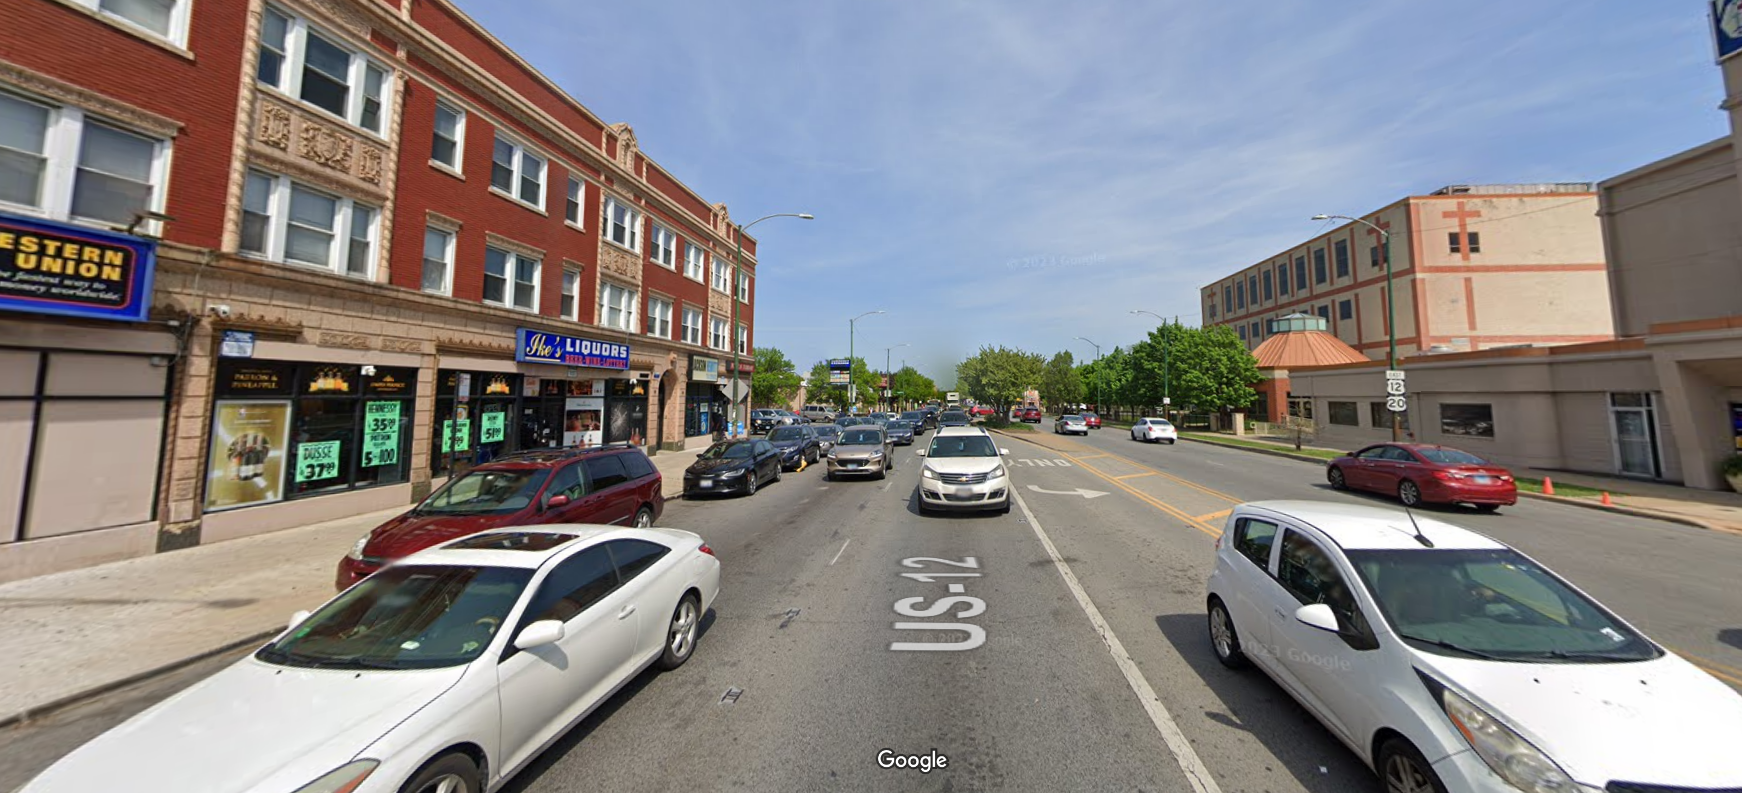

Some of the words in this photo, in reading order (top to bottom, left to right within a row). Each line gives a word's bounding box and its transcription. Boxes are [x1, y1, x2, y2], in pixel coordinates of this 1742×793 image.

[16, 253, 121, 281] UNION
[63, 279, 91, 291] way
[526, 333, 564, 358] Ike's
[565, 338, 627, 358] LIQUORS
[1390, 382, 1402, 392] 12
[1388, 398, 1405, 408] 20
[303, 445, 333, 460] DUSSE
[1006, 458, 1072, 467] ONLY
